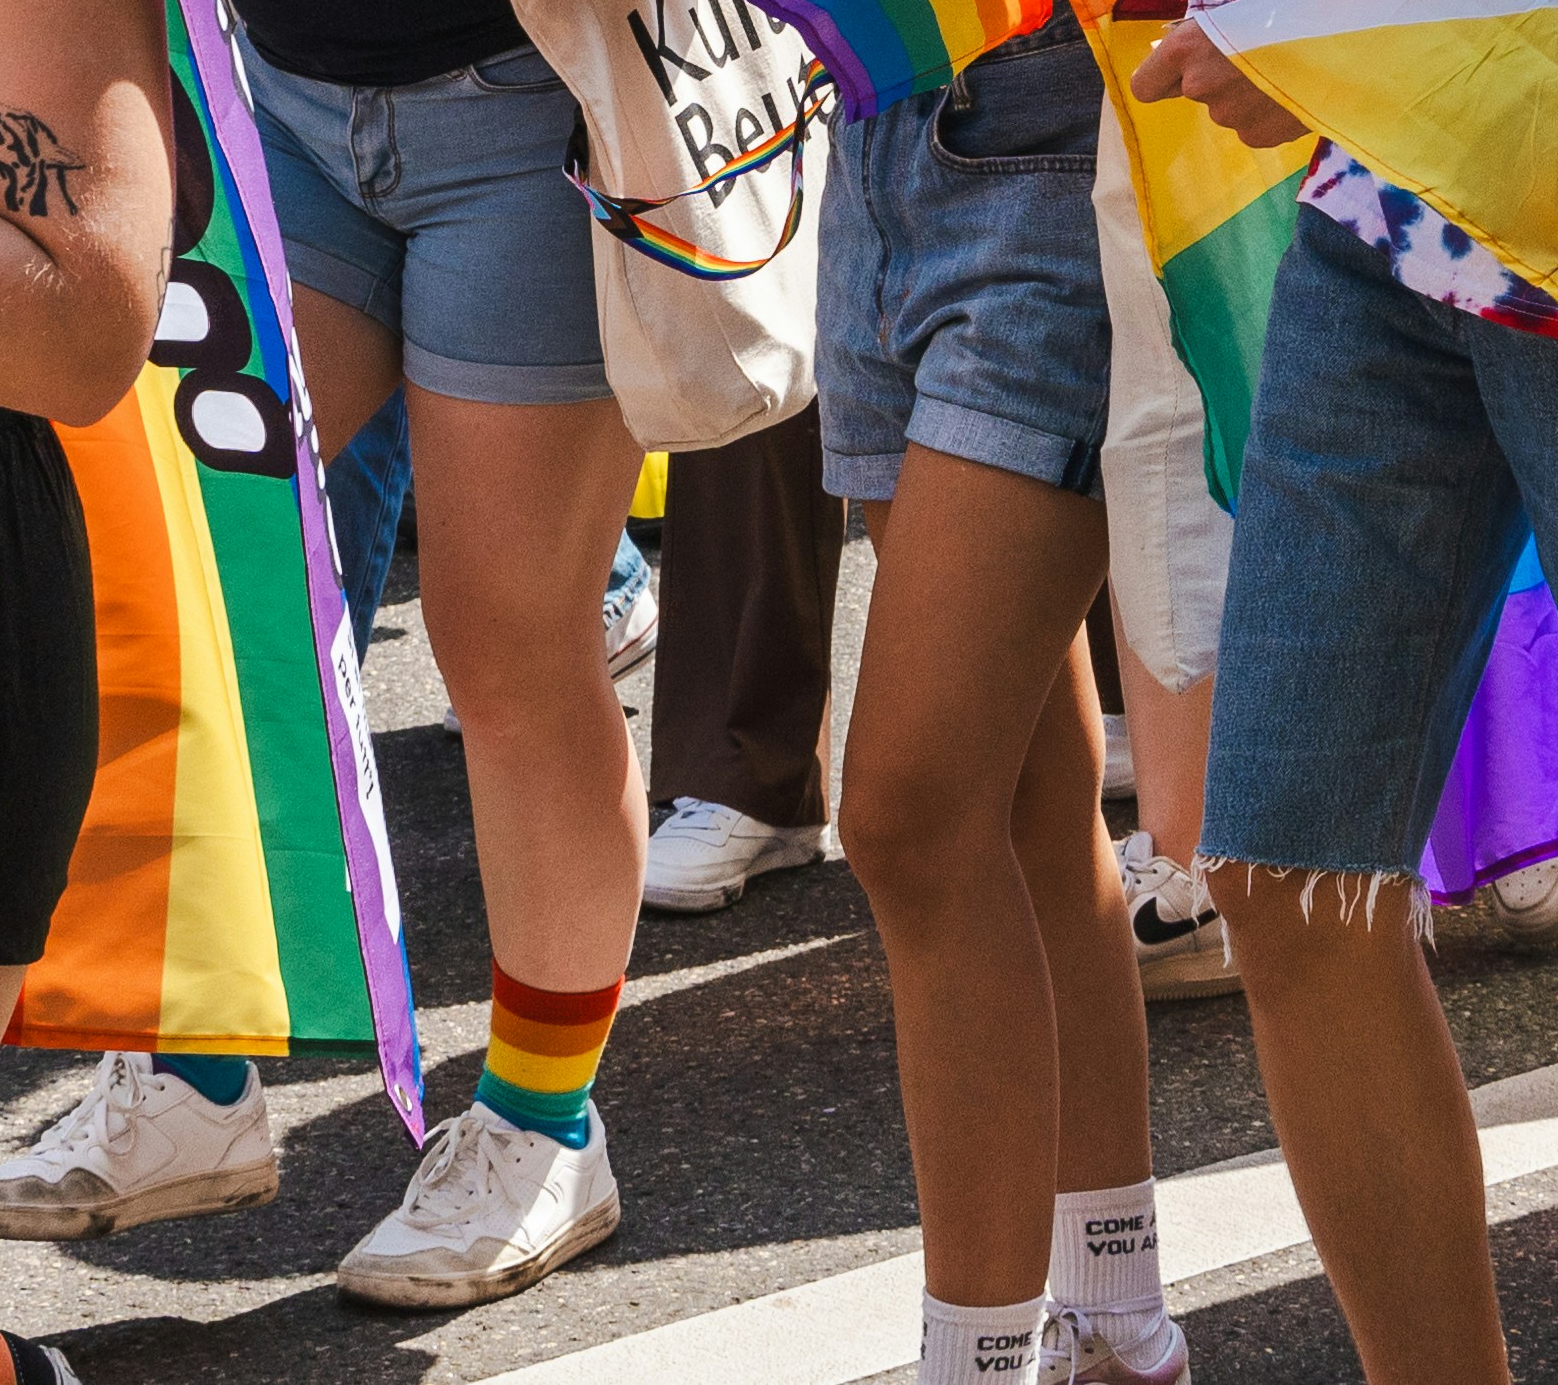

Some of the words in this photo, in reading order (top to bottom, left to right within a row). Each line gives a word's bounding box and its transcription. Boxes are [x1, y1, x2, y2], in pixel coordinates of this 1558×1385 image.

[1085, 1214, 1144, 1236] COME
[1087, 1240, 1135, 1257] YOU
[976, 1329, 1033, 1351] COME
[974, 1356, 1022, 1373] YOU
